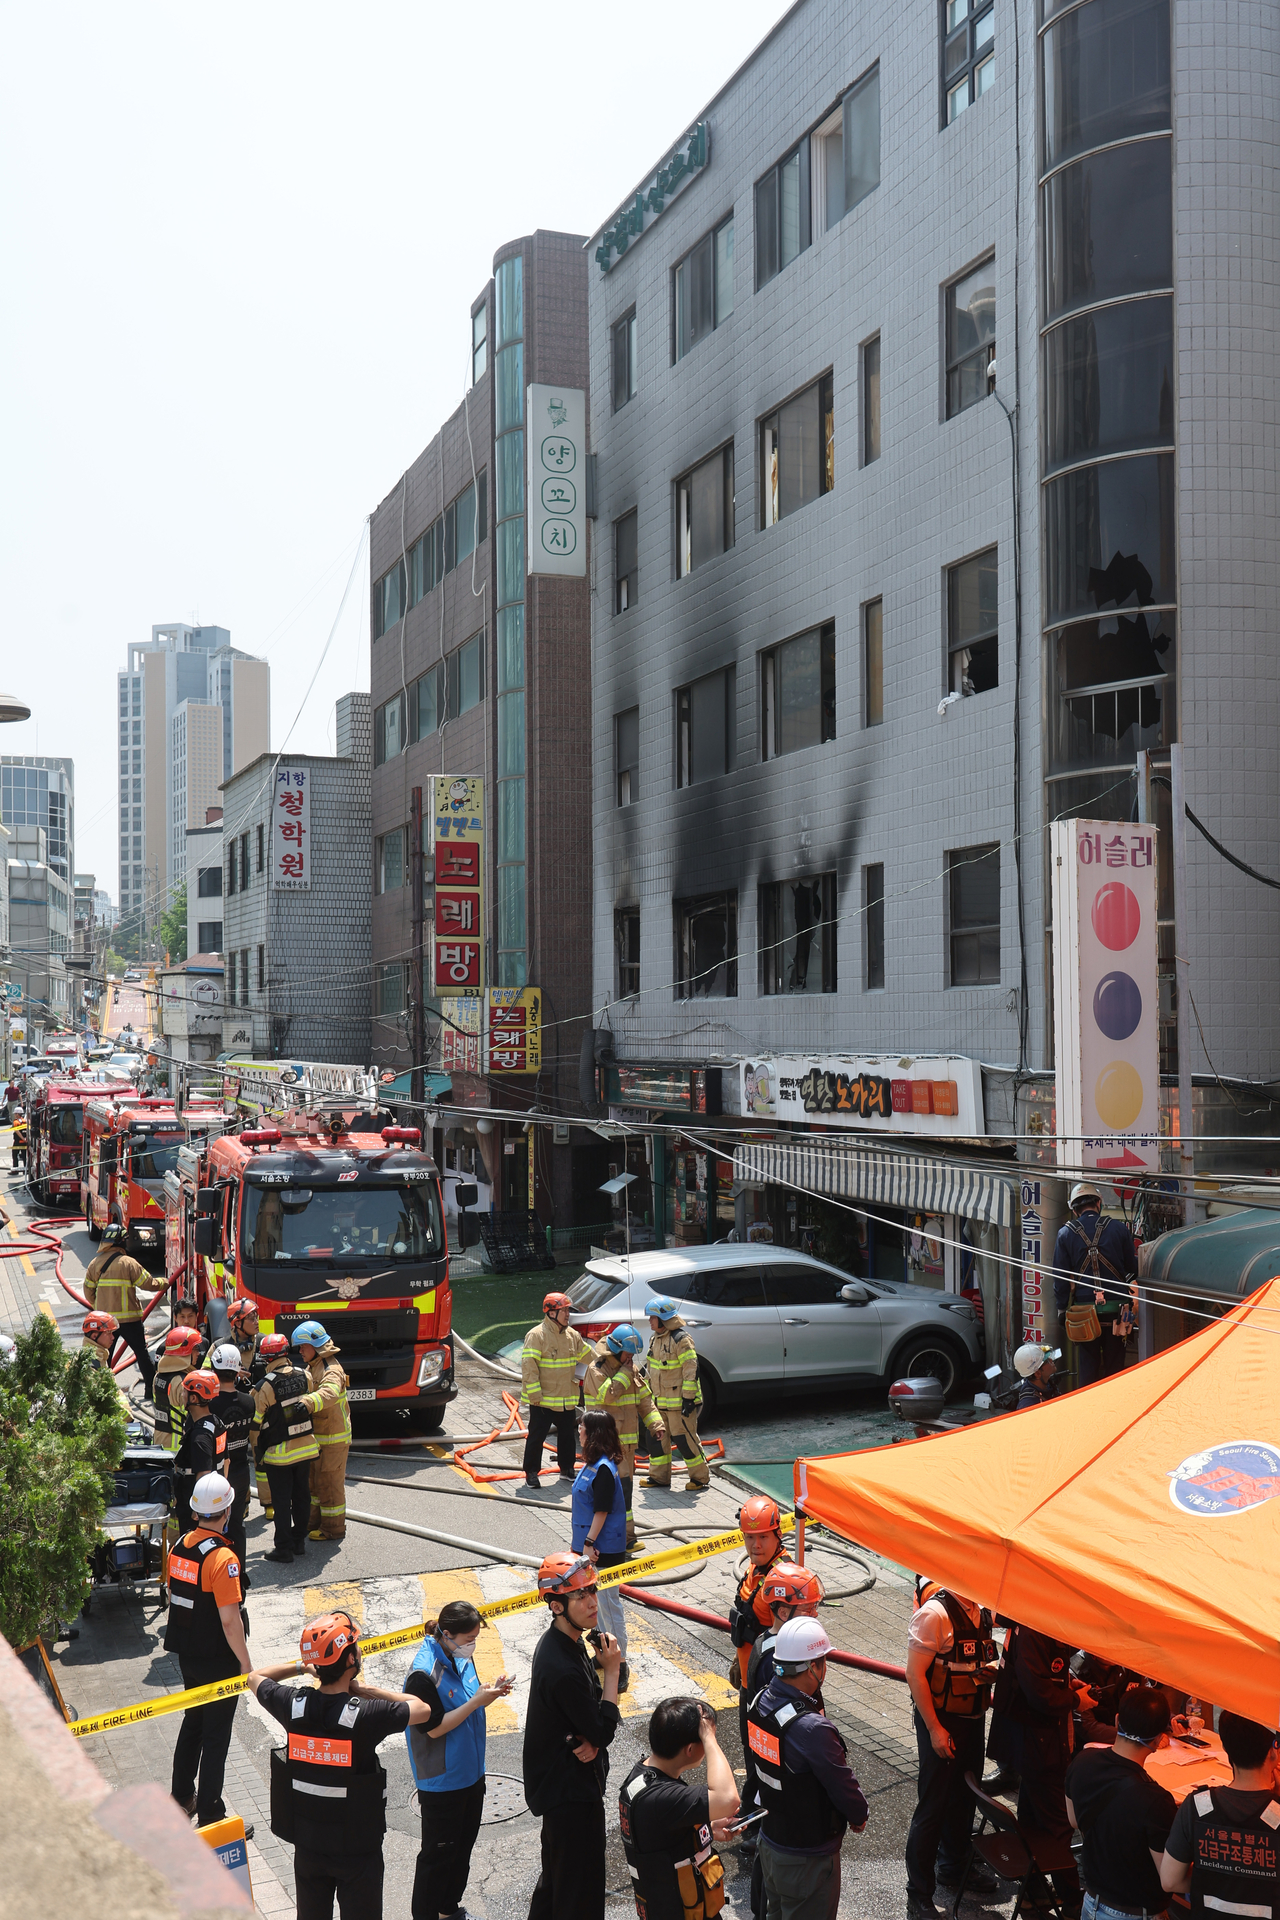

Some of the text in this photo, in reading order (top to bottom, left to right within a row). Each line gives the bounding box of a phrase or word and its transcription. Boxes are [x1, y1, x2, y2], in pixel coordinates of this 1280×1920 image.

[547, 445, 571, 549] 양꼬치
[278, 771, 306, 786] 지항
[279, 790, 306, 878] 철학원
[436, 816, 483, 837] 텔렌트
[1079, 832, 1152, 867] 허슬러
[439, 847, 476, 982] 노래방
[493, 1009, 522, 1068] 노래방
[893, 1085, 906, 1094] TAKE
[895, 1098, 906, 1107] OUT
[261, 1174, 290, 1183] 서울소방
[339, 1171, 358, 1180] 119
[351, 1390, 373, 1400] 2383
[1219, 1447, 1242, 1456] Seoul
[1244, 1447, 1259, 1455] Fire
[697, 1540, 721, 1555] 출입통제
[722, 1536, 738, 1548] FIRE
[622, 1567, 639, 1578] FIRE
[639, 1560, 657, 1572] LINE
[512, 1598, 530, 1612] FIRE
[531, 1595, 547, 1606] LIN
[360, 1629, 426, 1655] 입통제 FIRE LIN
[103, 1713, 126, 1728] FIRE
[129, 1706, 155, 1722] LINE
[292, 1747, 349, 1764] 긴급구조통제단
[1198, 1839, 1277, 1868] 긴급구조통제단
[1200, 1859, 1277, 1877] Incident Command
